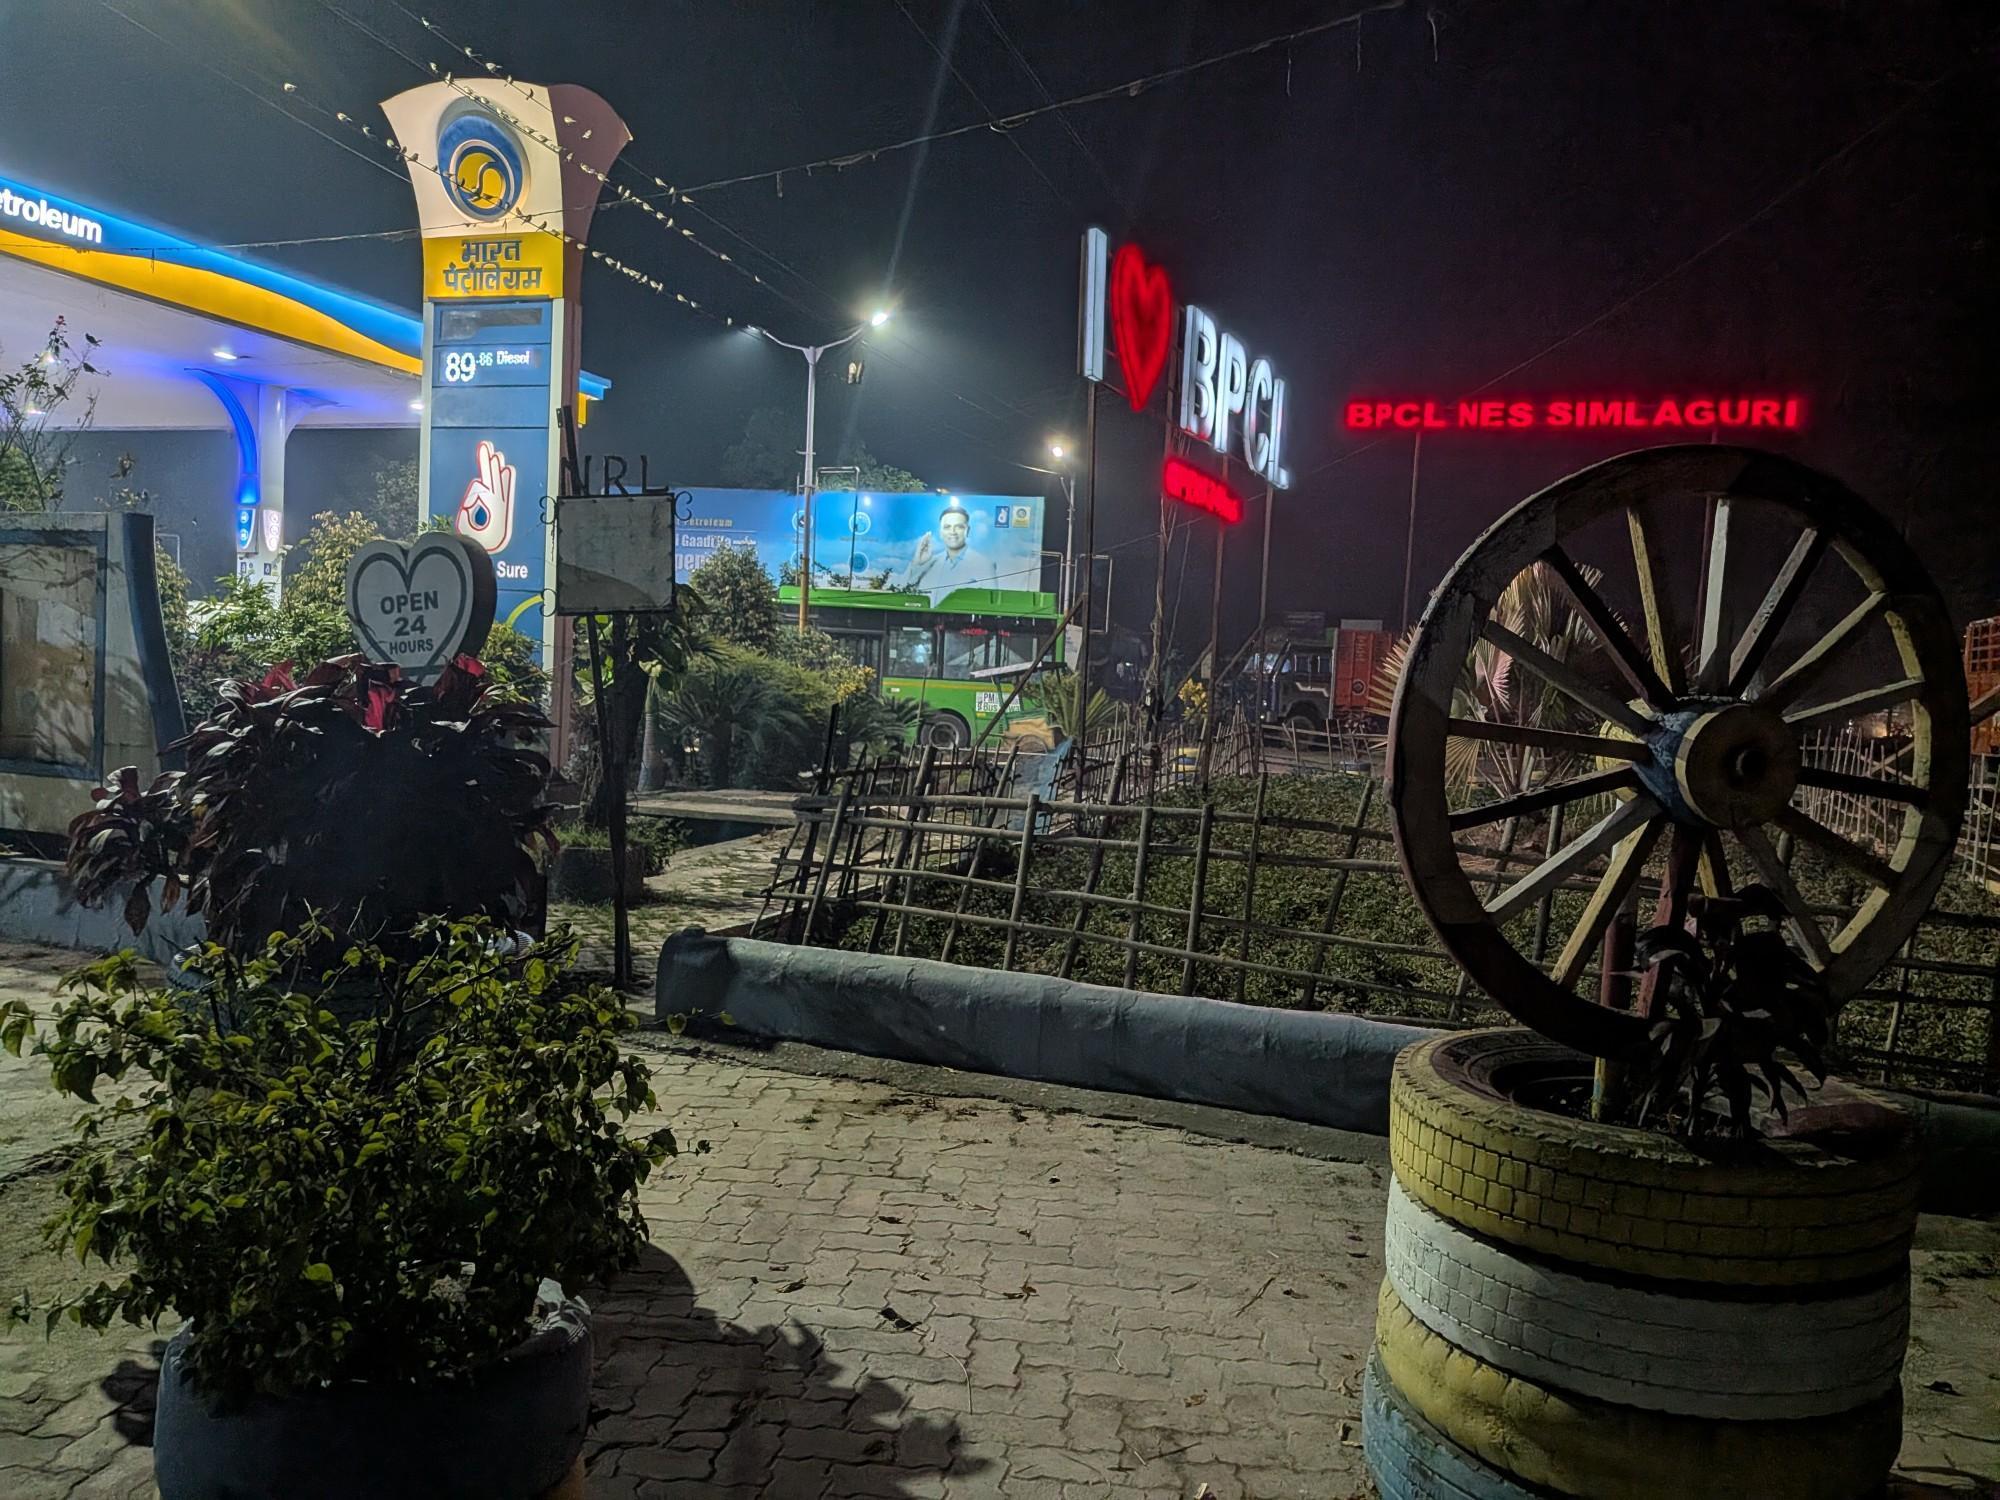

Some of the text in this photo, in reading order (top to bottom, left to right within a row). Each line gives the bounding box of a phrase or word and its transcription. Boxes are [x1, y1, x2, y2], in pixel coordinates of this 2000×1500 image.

[0, 188, 102, 243] troleum
[461, 240, 522, 262] भारत
[496, 350, 530, 365] Diesel
[1082, 227, 1289, 489] I BPCL
[1346, 400, 1798, 428] BPCL NES SIMLAGURI
[496, 561, 528, 579] Sure
[380, 591, 439, 615] OPEN
[394, 616, 427, 637] 24
[389, 638, 434, 655] HOURS
